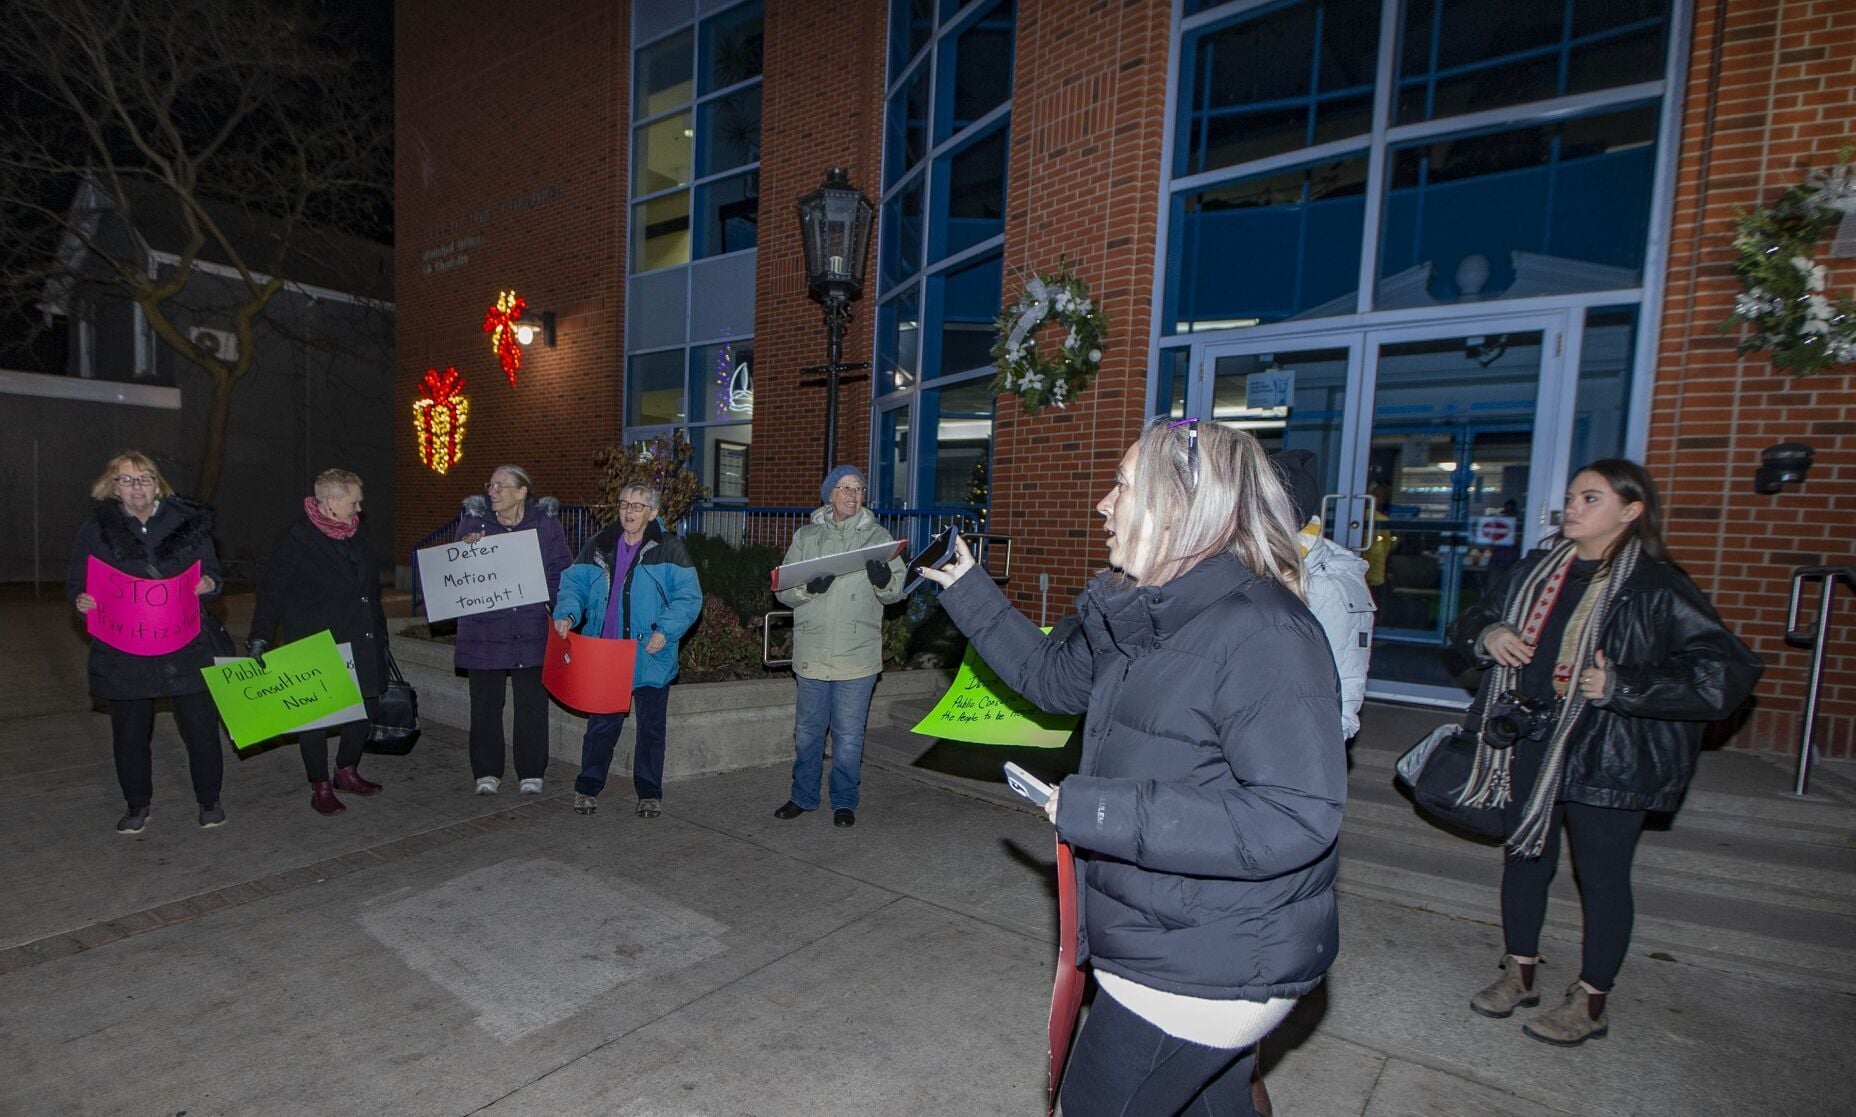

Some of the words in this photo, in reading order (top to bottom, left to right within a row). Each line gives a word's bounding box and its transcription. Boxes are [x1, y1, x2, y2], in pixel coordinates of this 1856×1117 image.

[446, 542, 499, 562] Defer
[443, 572, 497, 588] Motion
[109, 573, 190, 607] STOP
[222, 661, 272, 684] Public
[952, 694, 975, 709] Public
[995, 710, 1005, 720] be
